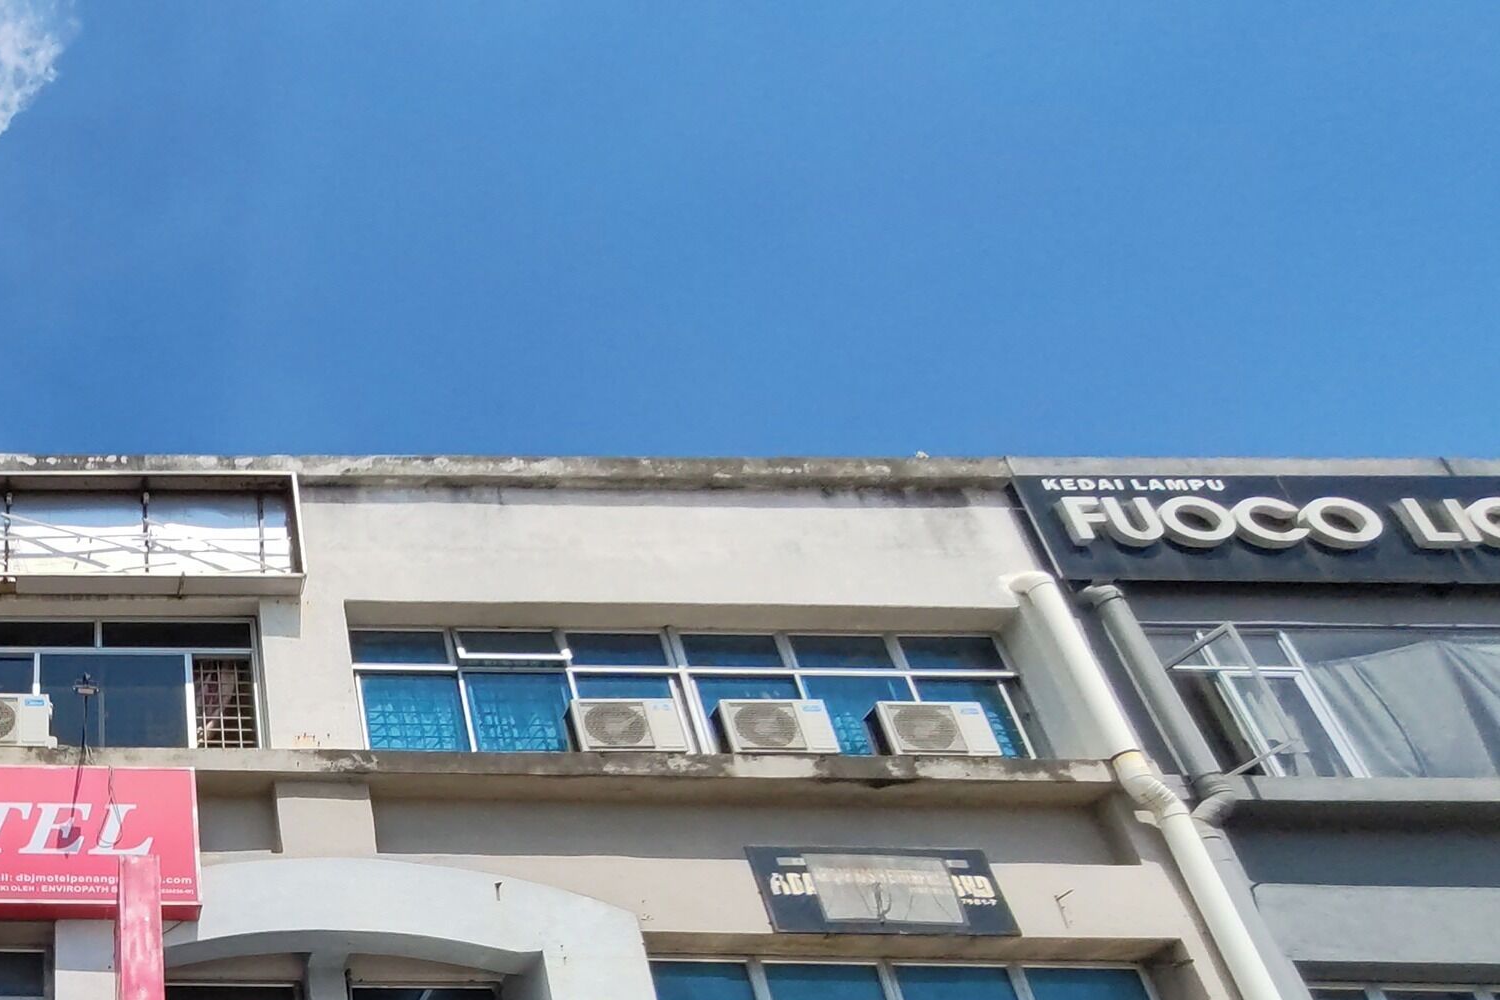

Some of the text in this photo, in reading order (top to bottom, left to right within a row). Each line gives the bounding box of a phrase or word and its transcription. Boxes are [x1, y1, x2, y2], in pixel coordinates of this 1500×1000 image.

[1041, 478, 1227, 492] KEDAI LAMPU
[1057, 495, 1384, 549] FUOCO
[41, 885, 110, 893] ENVIROPATH
